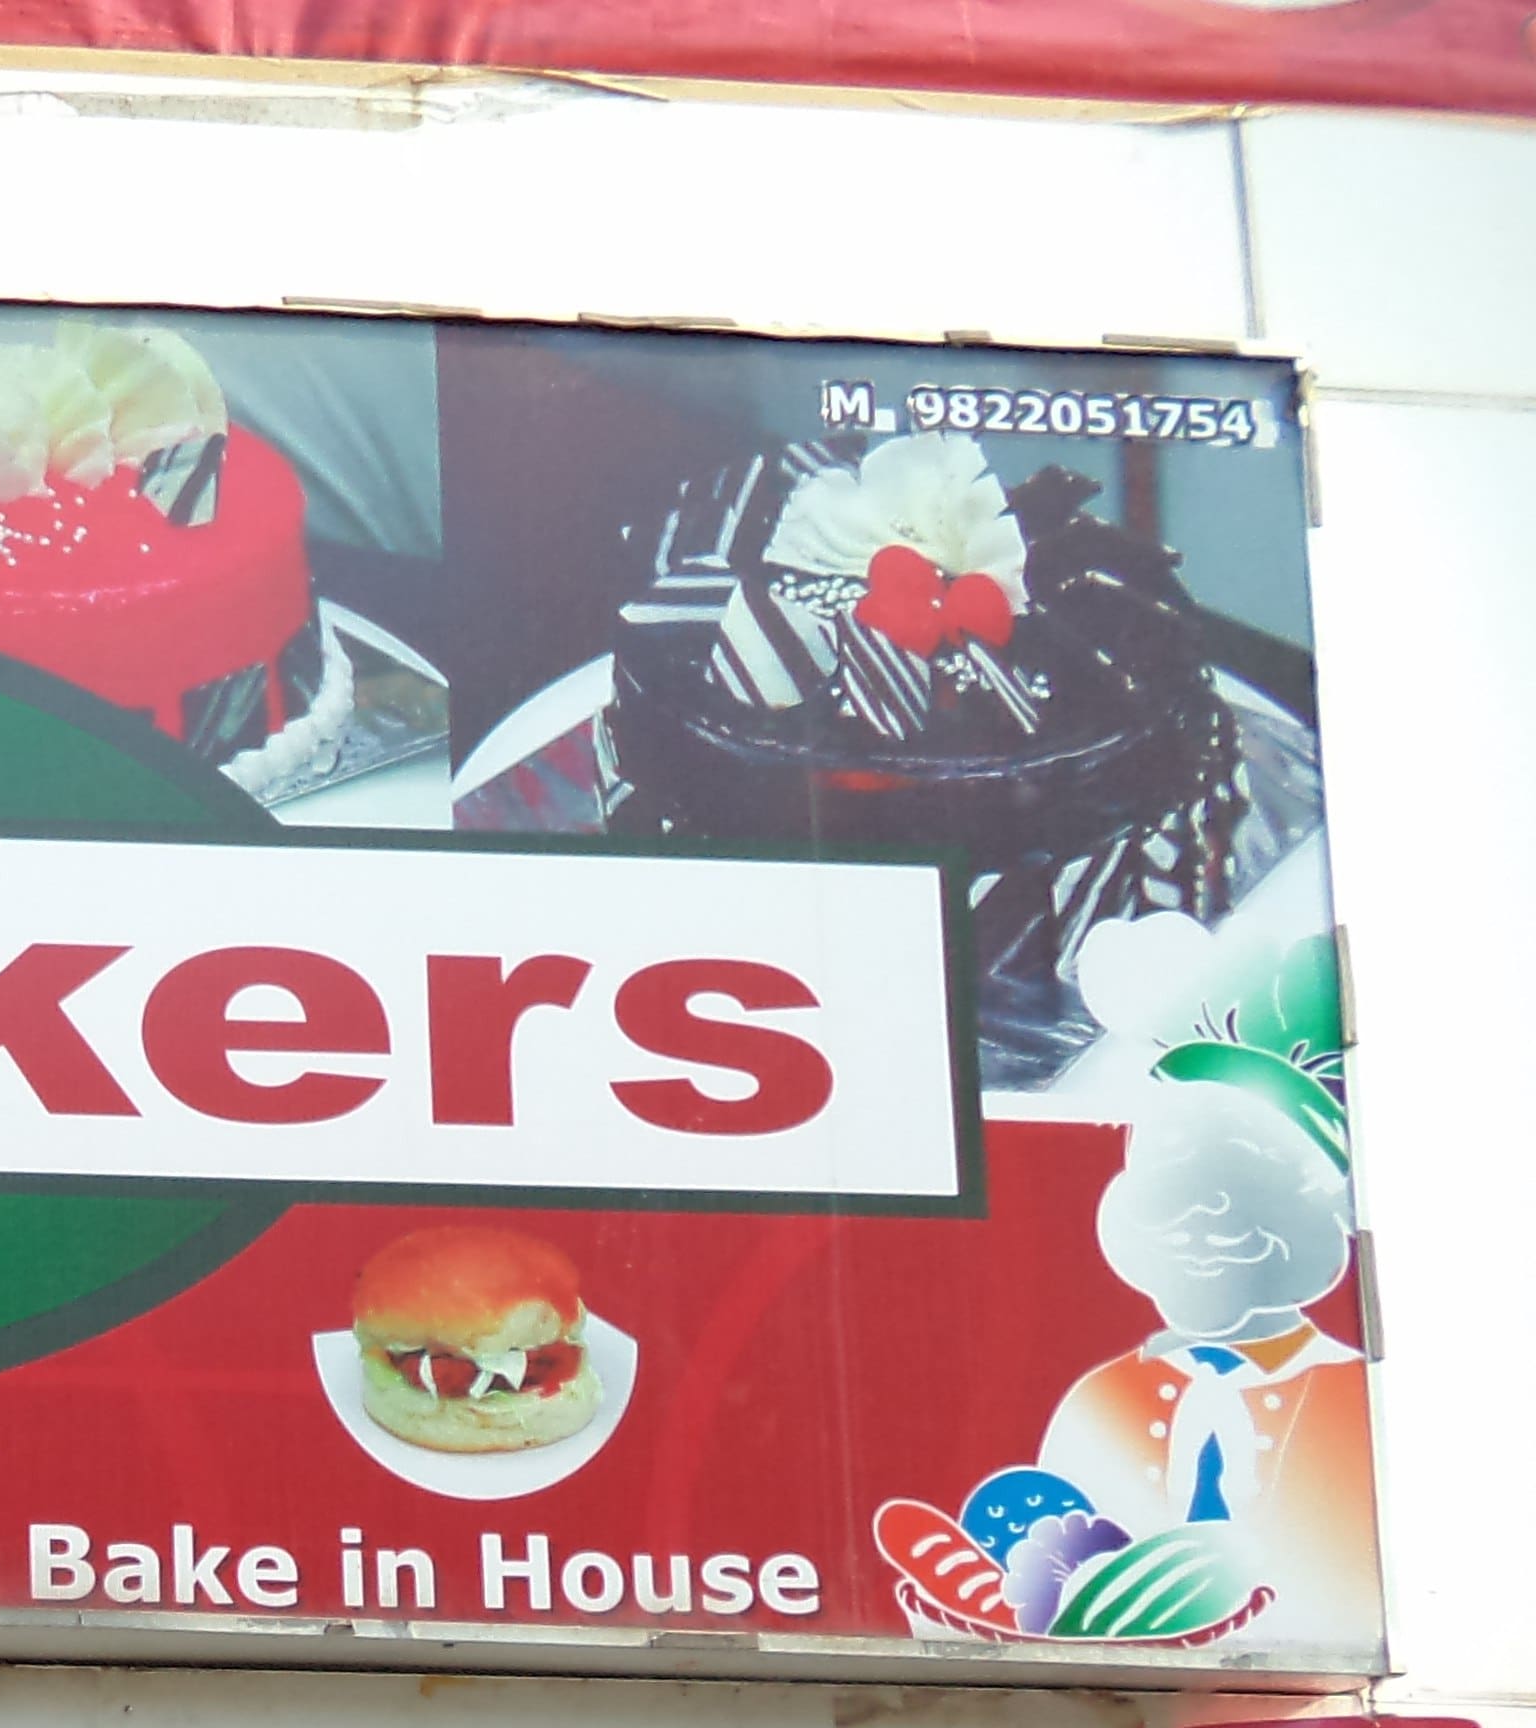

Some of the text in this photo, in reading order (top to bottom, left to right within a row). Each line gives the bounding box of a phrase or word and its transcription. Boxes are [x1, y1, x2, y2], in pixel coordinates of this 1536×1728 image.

[910, 387, 1252, 442] 9822051754
[28, 1521, 299, 1609] Bake
[339, 1526, 436, 1611] in
[480, 1531, 822, 1617] House
